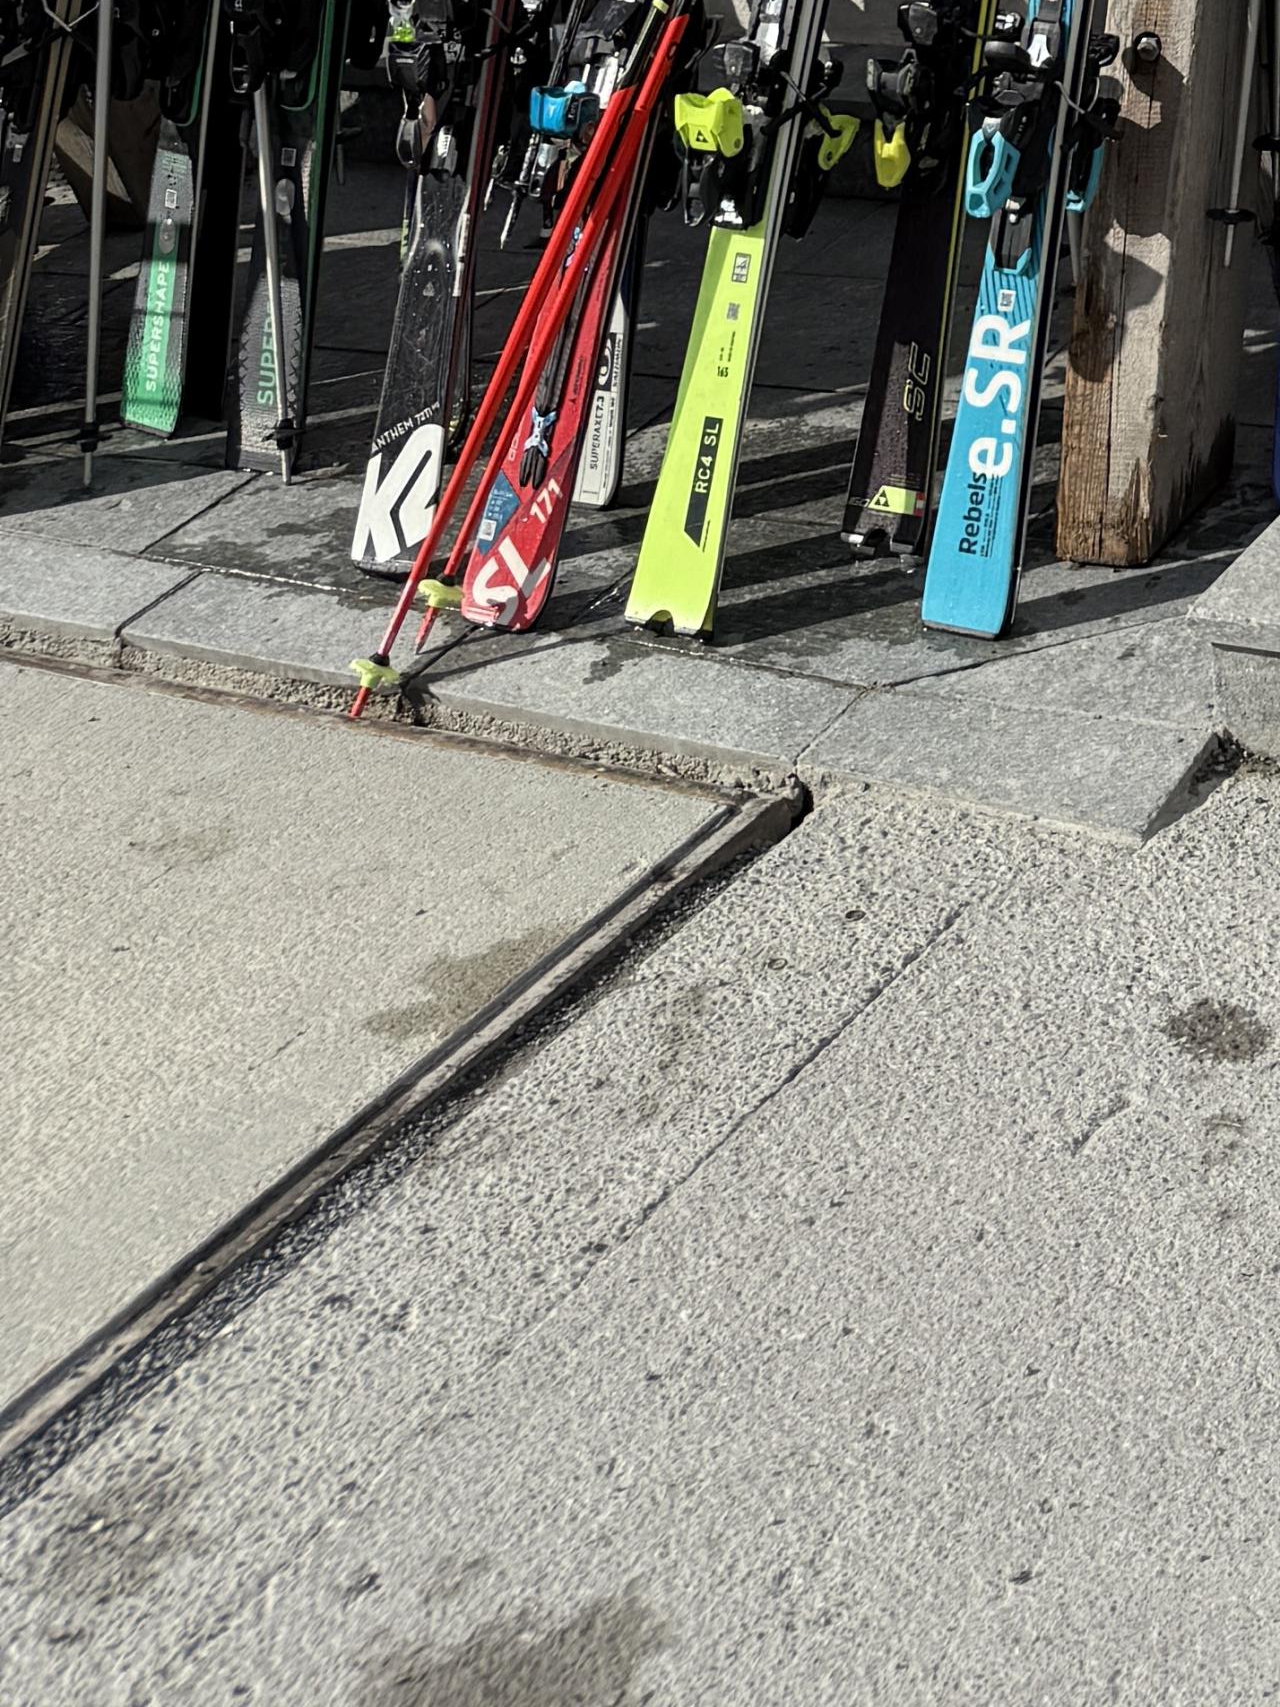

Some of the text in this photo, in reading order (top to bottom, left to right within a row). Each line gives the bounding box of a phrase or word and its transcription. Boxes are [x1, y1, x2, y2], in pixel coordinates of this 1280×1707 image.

[145, 258, 171, 393] SUPERSHAPE
[371, 418, 415, 454] ANTHEM
[964, 314, 1032, 480] e.SR
[351, 423, 445, 564] K2
[529, 478, 564, 524] 171
[694, 422, 721, 494] RC4 SL
[959, 470, 988, 556] Rebels
